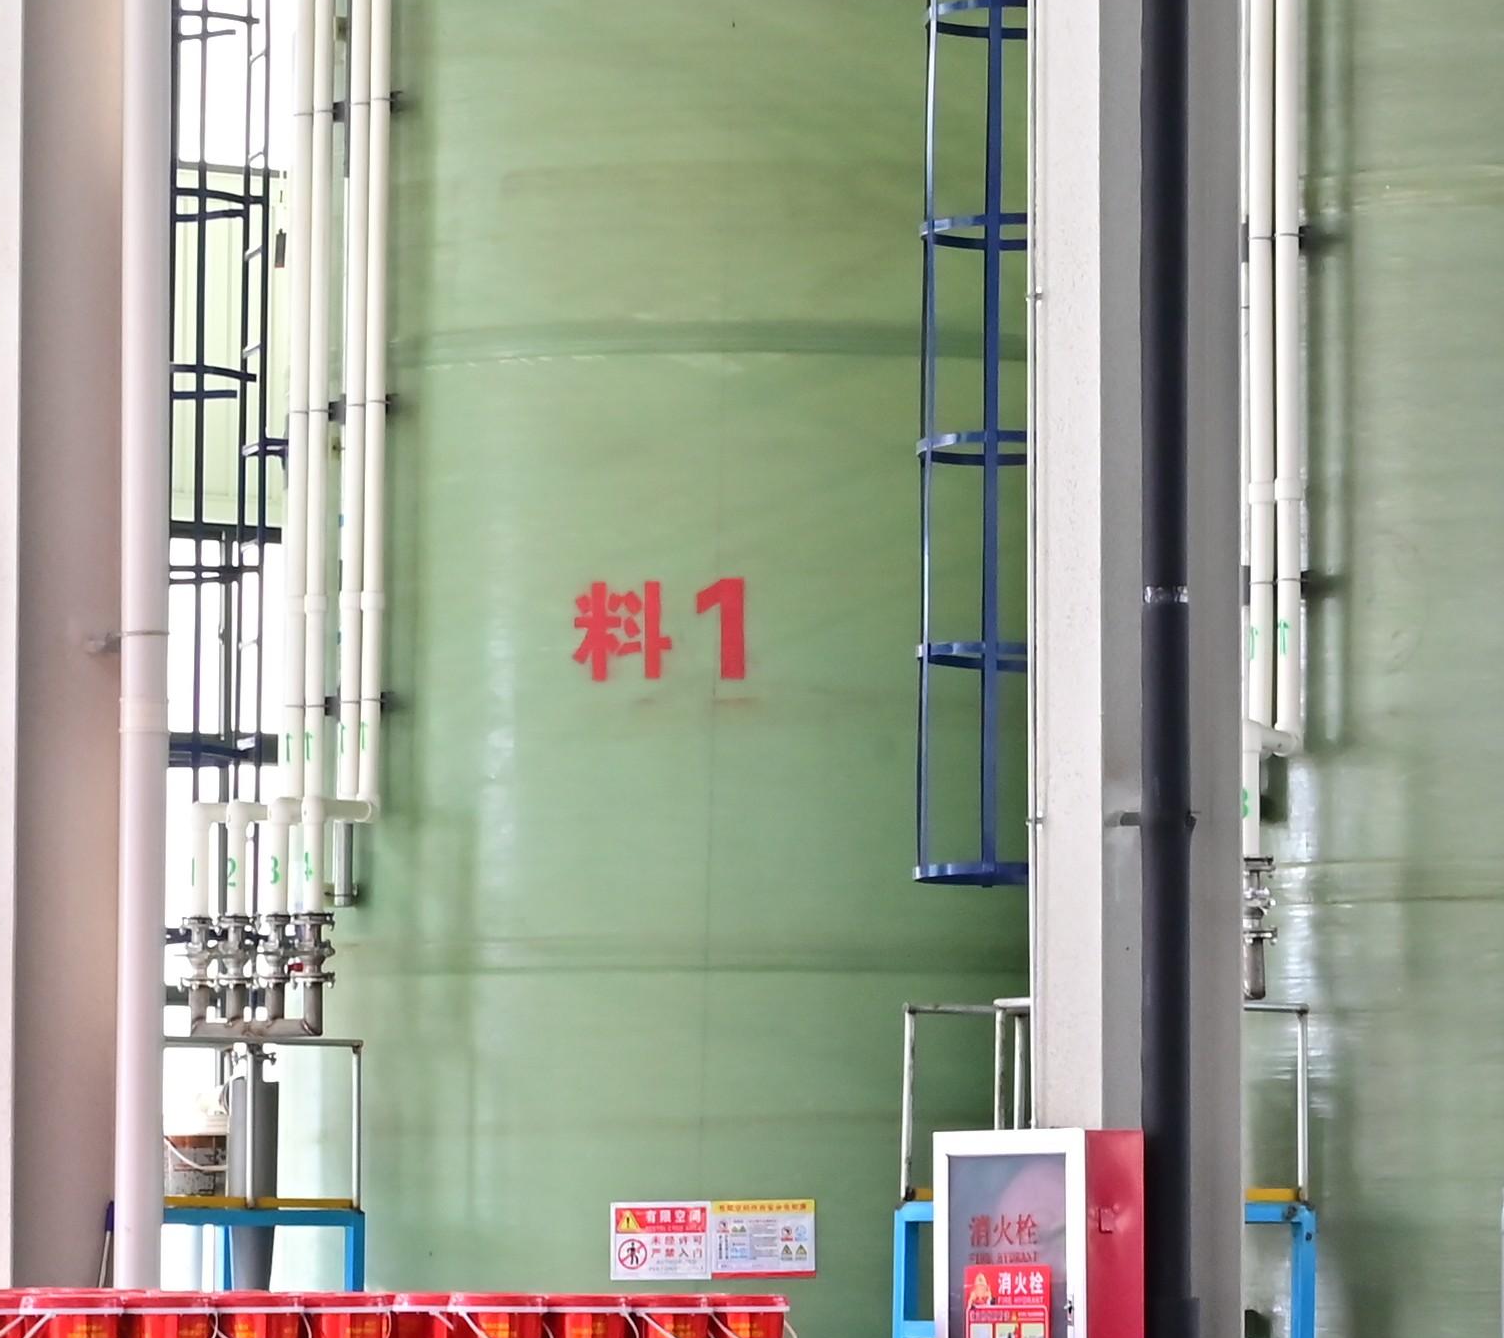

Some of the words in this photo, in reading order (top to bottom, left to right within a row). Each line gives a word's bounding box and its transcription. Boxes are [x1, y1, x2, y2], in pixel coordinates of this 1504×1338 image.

[572, 577, 745, 682] 料1
[647, 1209, 702, 1224] 有限空间
[650, 1235, 704, 1246] 未经许可
[969, 1214, 1039, 1248] 消火栓
[998, 1272, 1045, 1295] 消火栓
